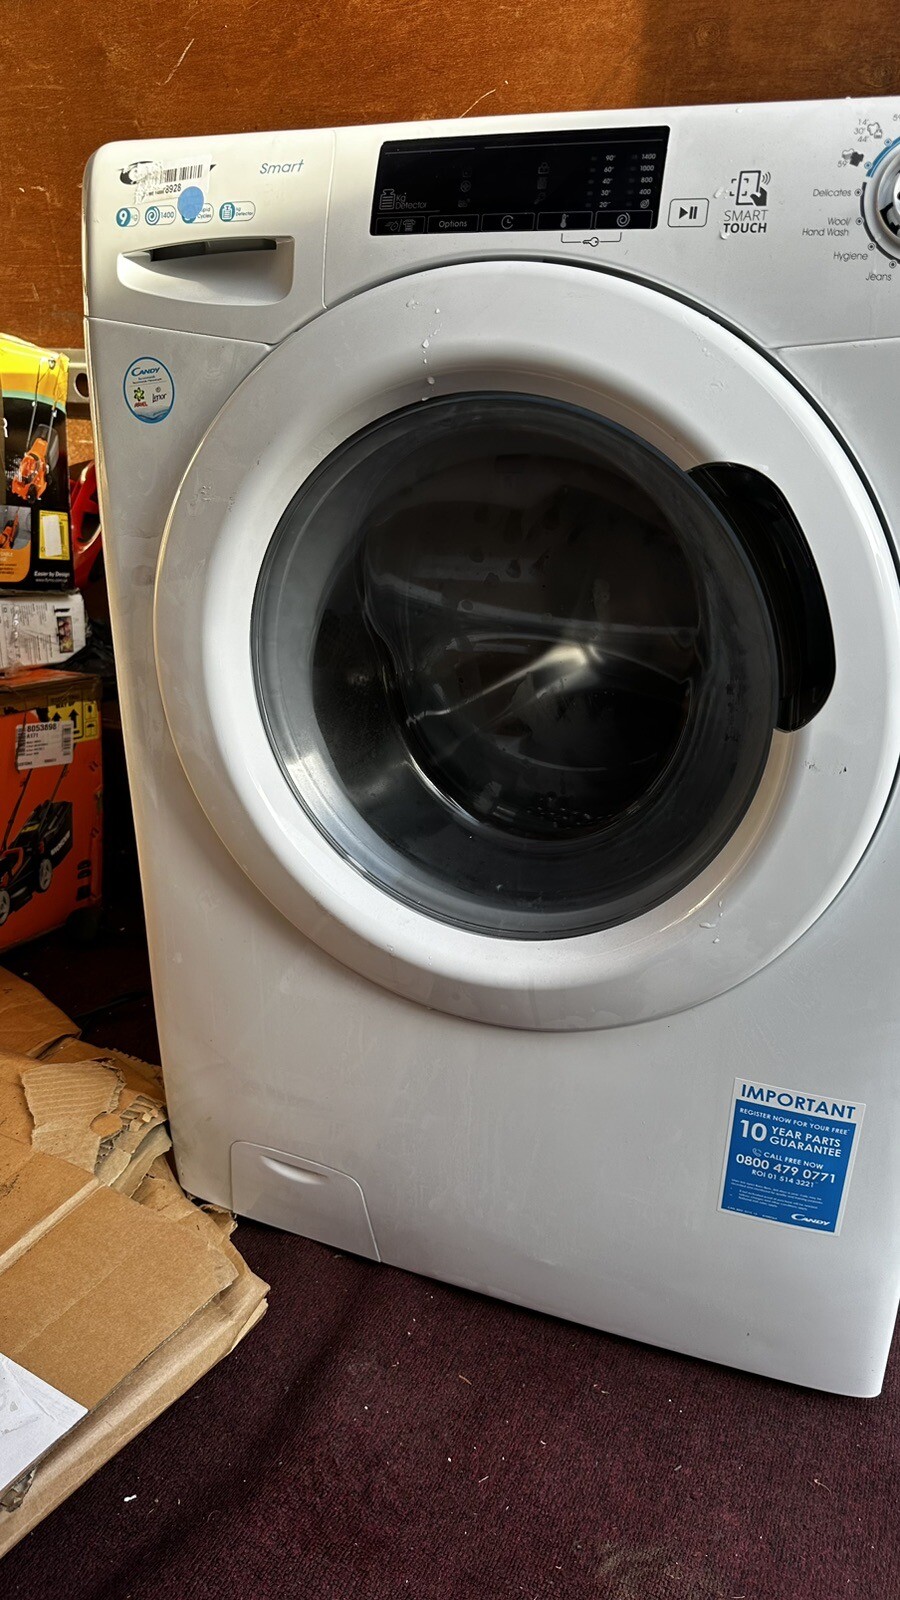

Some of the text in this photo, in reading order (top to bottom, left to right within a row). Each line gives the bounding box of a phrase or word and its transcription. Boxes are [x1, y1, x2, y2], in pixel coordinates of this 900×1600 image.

[260, 159, 304, 174] Smart
[163, 183, 182, 194] 8928
[813, 188, 852, 197] Delicates
[395, 202, 427, 210] Detector
[119, 209, 128, 225] 9
[724, 210, 768, 221] SMART
[438, 220, 468, 229] Options
[723, 223, 767, 233] TOUCH
[802, 228, 850, 236] Hand Wash
[833, 251, 869, 262] Hygiene
[865, 272, 892, 281] Jeans
[26, 723, 57, 733] 8053898
[741, 1084, 856, 1119] IMPORTANT
[740, 1107, 771, 1120] REGISTER
[772, 1115, 792, 1124] NOW
[793, 1119, 808, 1128] FOR
[809, 1122, 830, 1132] YOUR
[740, 1119, 841, 1147] 10 YEAR PARTS
[769, 1136, 842, 1157] GUARANTEE
[763, 1151, 824, 1170] CALL FREE NOW
[736, 1153, 835, 1183] 0800 479 0771
[751, 1169, 766, 1177] ROI
[767, 1172, 777, 1180] 01
[780, 1175, 793, 1184] 514
